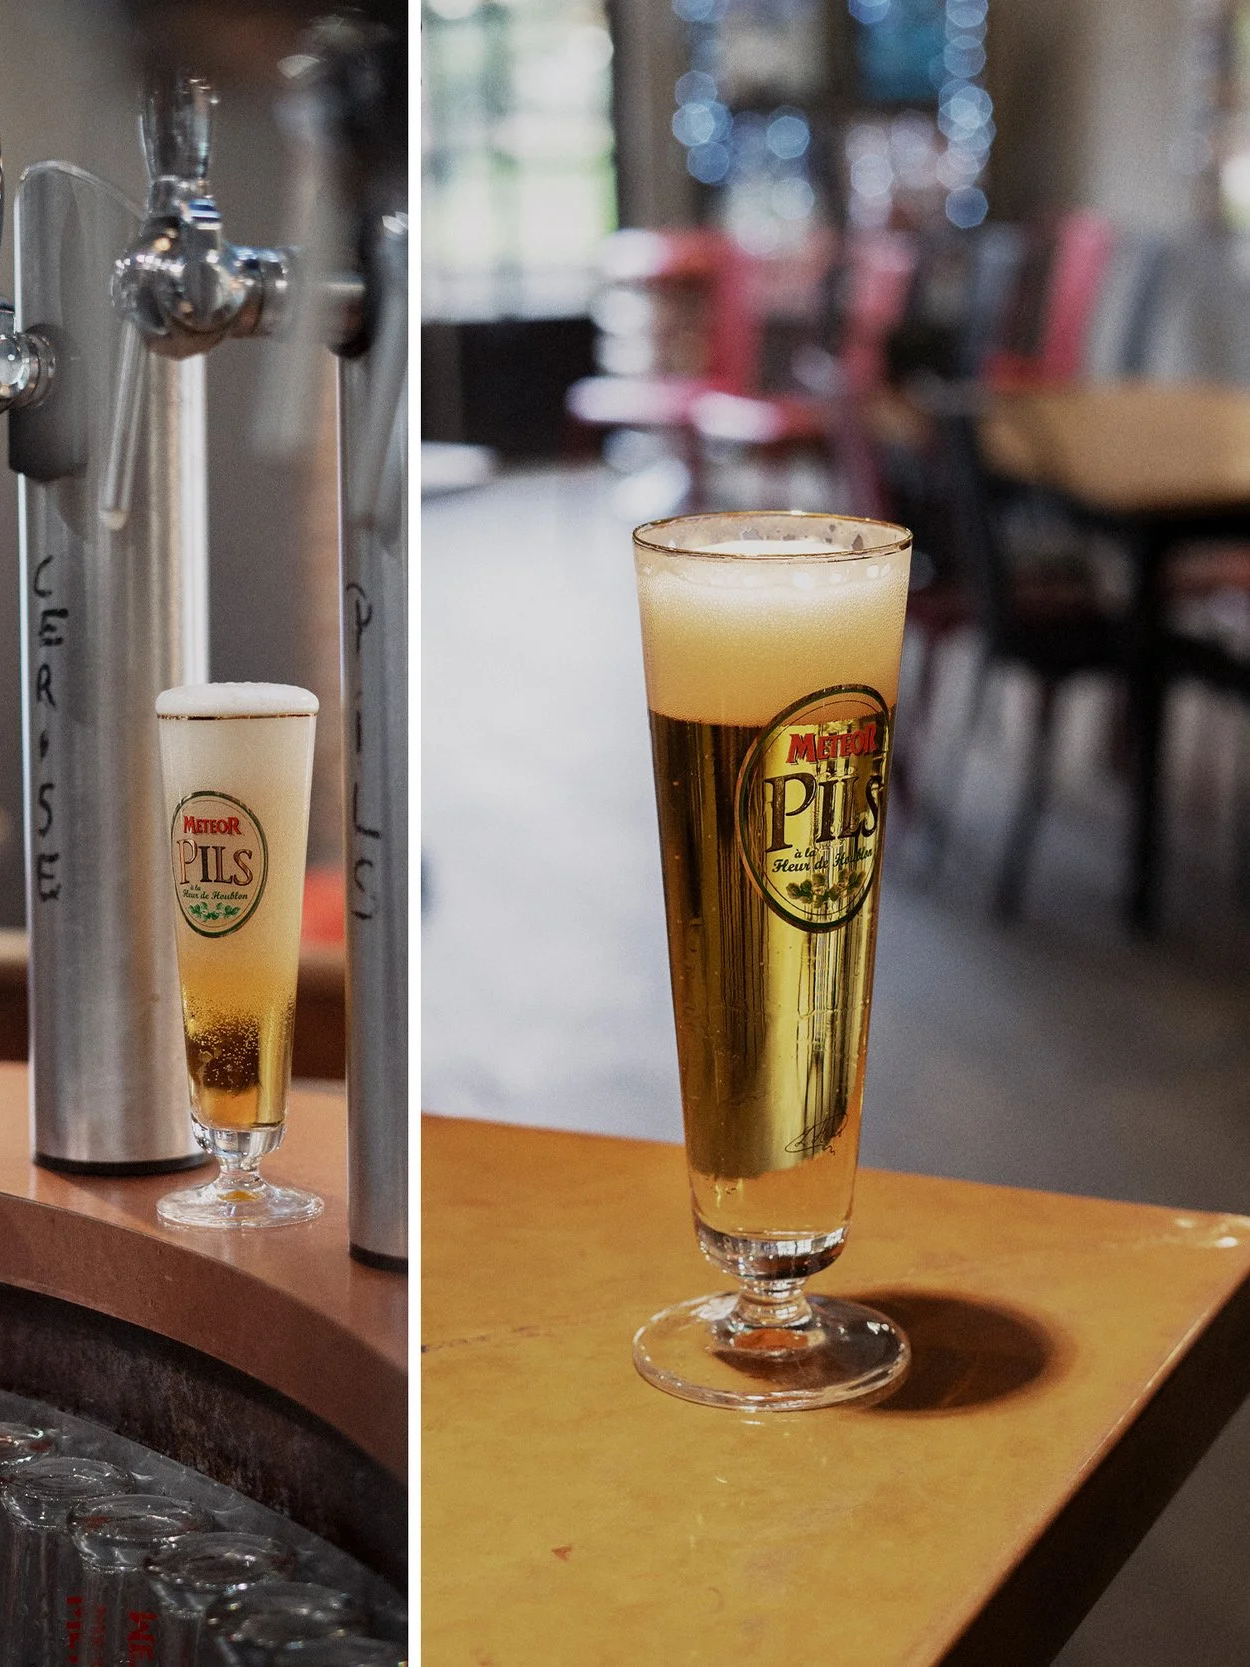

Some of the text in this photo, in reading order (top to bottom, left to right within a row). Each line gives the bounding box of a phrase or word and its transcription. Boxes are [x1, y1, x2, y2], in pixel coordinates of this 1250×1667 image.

[33, 555, 69, 902] CERISE
[785, 724, 877, 765] METEOR
[183, 815, 241, 835] METEOR
[762, 772, 885, 853] PILS
[176, 839, 253, 886] PILS
[772, 859, 810, 873] Fleur
[814, 856, 829, 869] de
[794, 847, 816, 858] à la
[200, 891, 209, 899] de
[211, 890, 248, 900] Houblon
